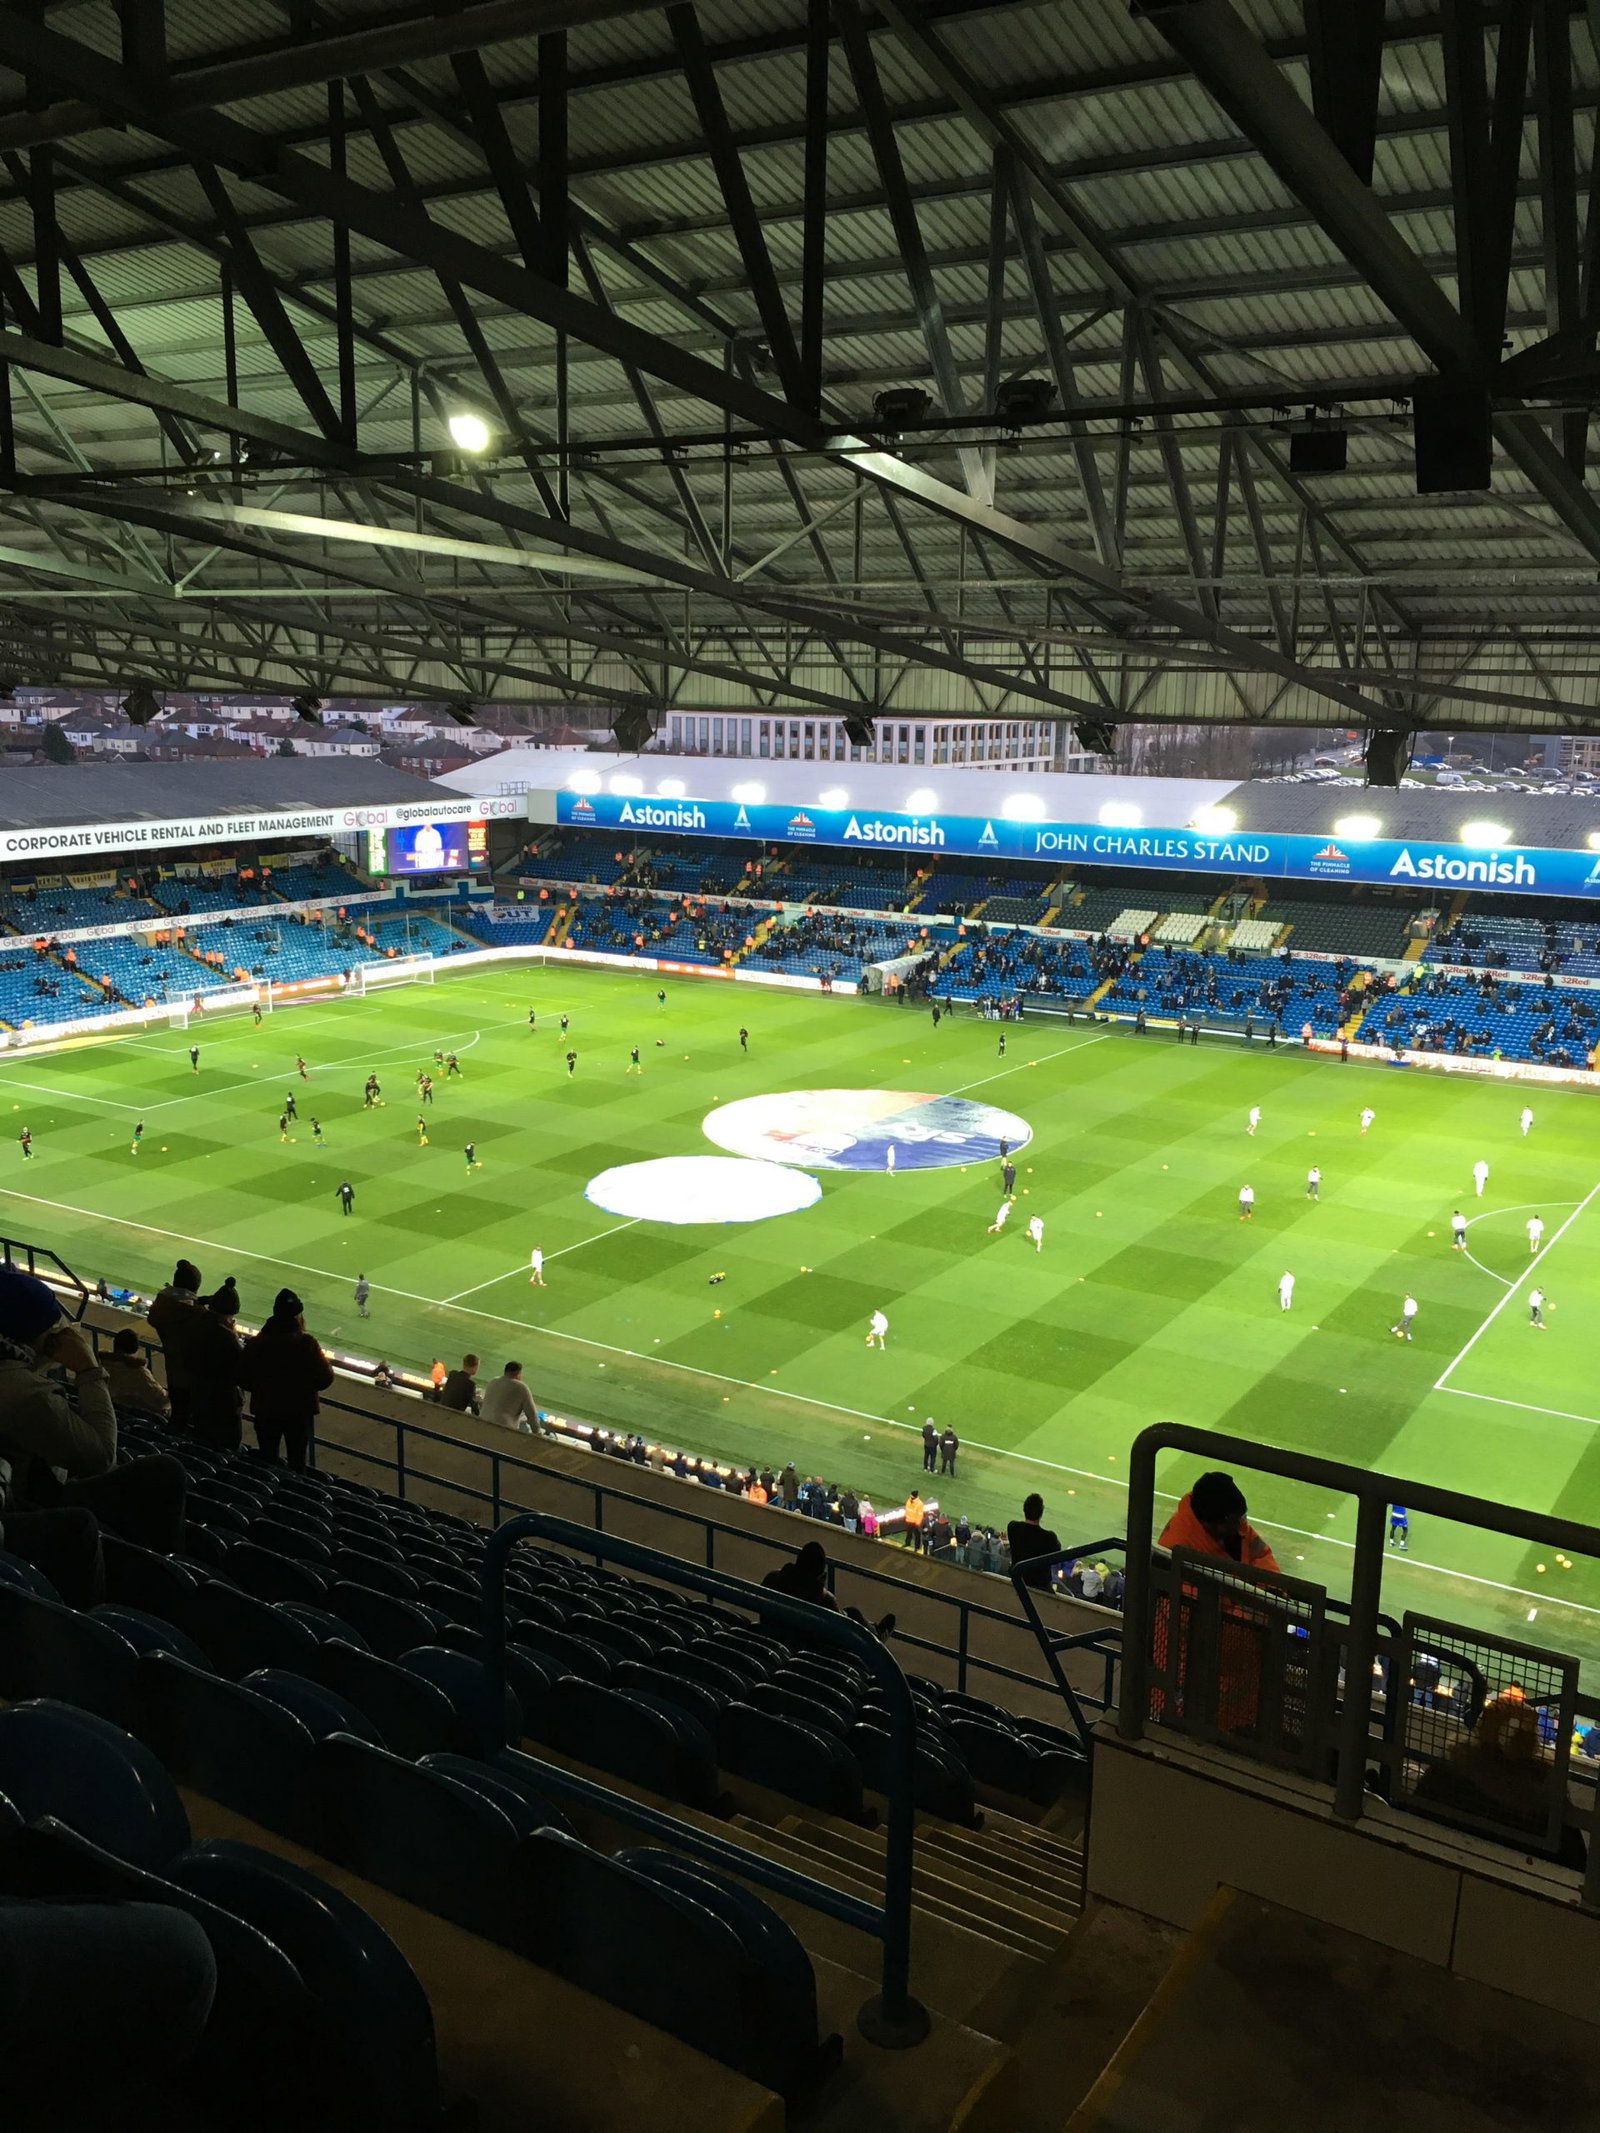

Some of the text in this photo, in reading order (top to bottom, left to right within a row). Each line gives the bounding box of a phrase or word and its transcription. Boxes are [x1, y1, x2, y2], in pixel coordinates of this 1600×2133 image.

[396, 804, 472, 821] @globalautocare
[619, 801, 706, 829] Astonish
[6, 815, 334, 851] CORPORATE VEHICLE RENTAL AND FLEET MANAGEMENT
[843, 815, 945, 846] Astonish
[1035, 831, 1270, 863] JOHN CHARLES STAND
[1319, 867, 1350, 875] CLEANING
[1322, 861, 1351, 869] PINNACLE
[1389, 848, 1536, 885] Astonish
[1304, 952, 1329, 961] 32Red
[1561, 976, 1590, 986] 32Red
